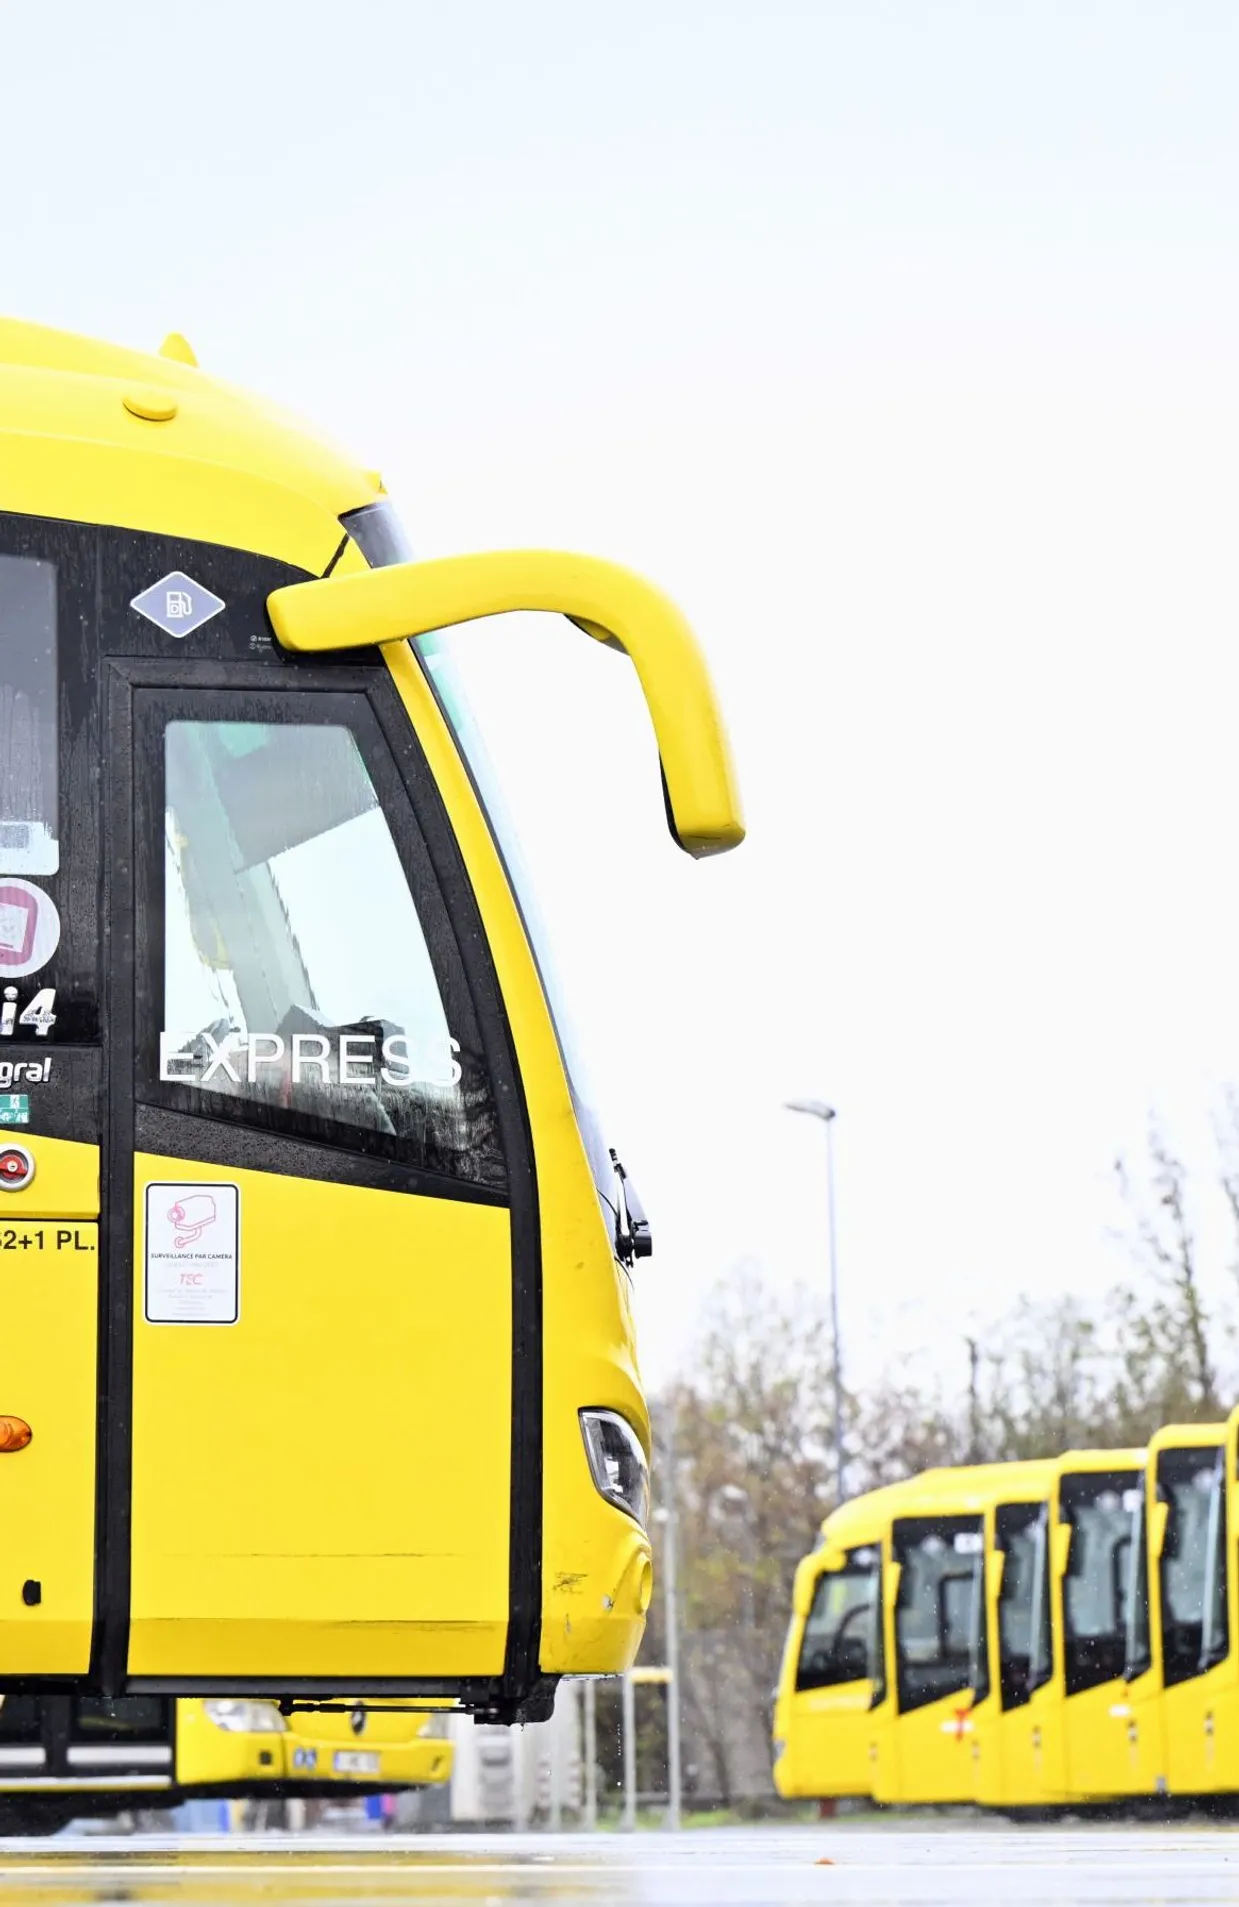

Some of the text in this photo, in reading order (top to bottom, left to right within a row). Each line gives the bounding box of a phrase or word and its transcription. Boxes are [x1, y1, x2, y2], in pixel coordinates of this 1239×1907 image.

[0, 986, 56, 1036] i4
[159, 1031, 462, 1087] EXPRESS
[0, 1230, 95, 1250] 2+1 PL.
[180, 1273, 204, 1285] TEC
